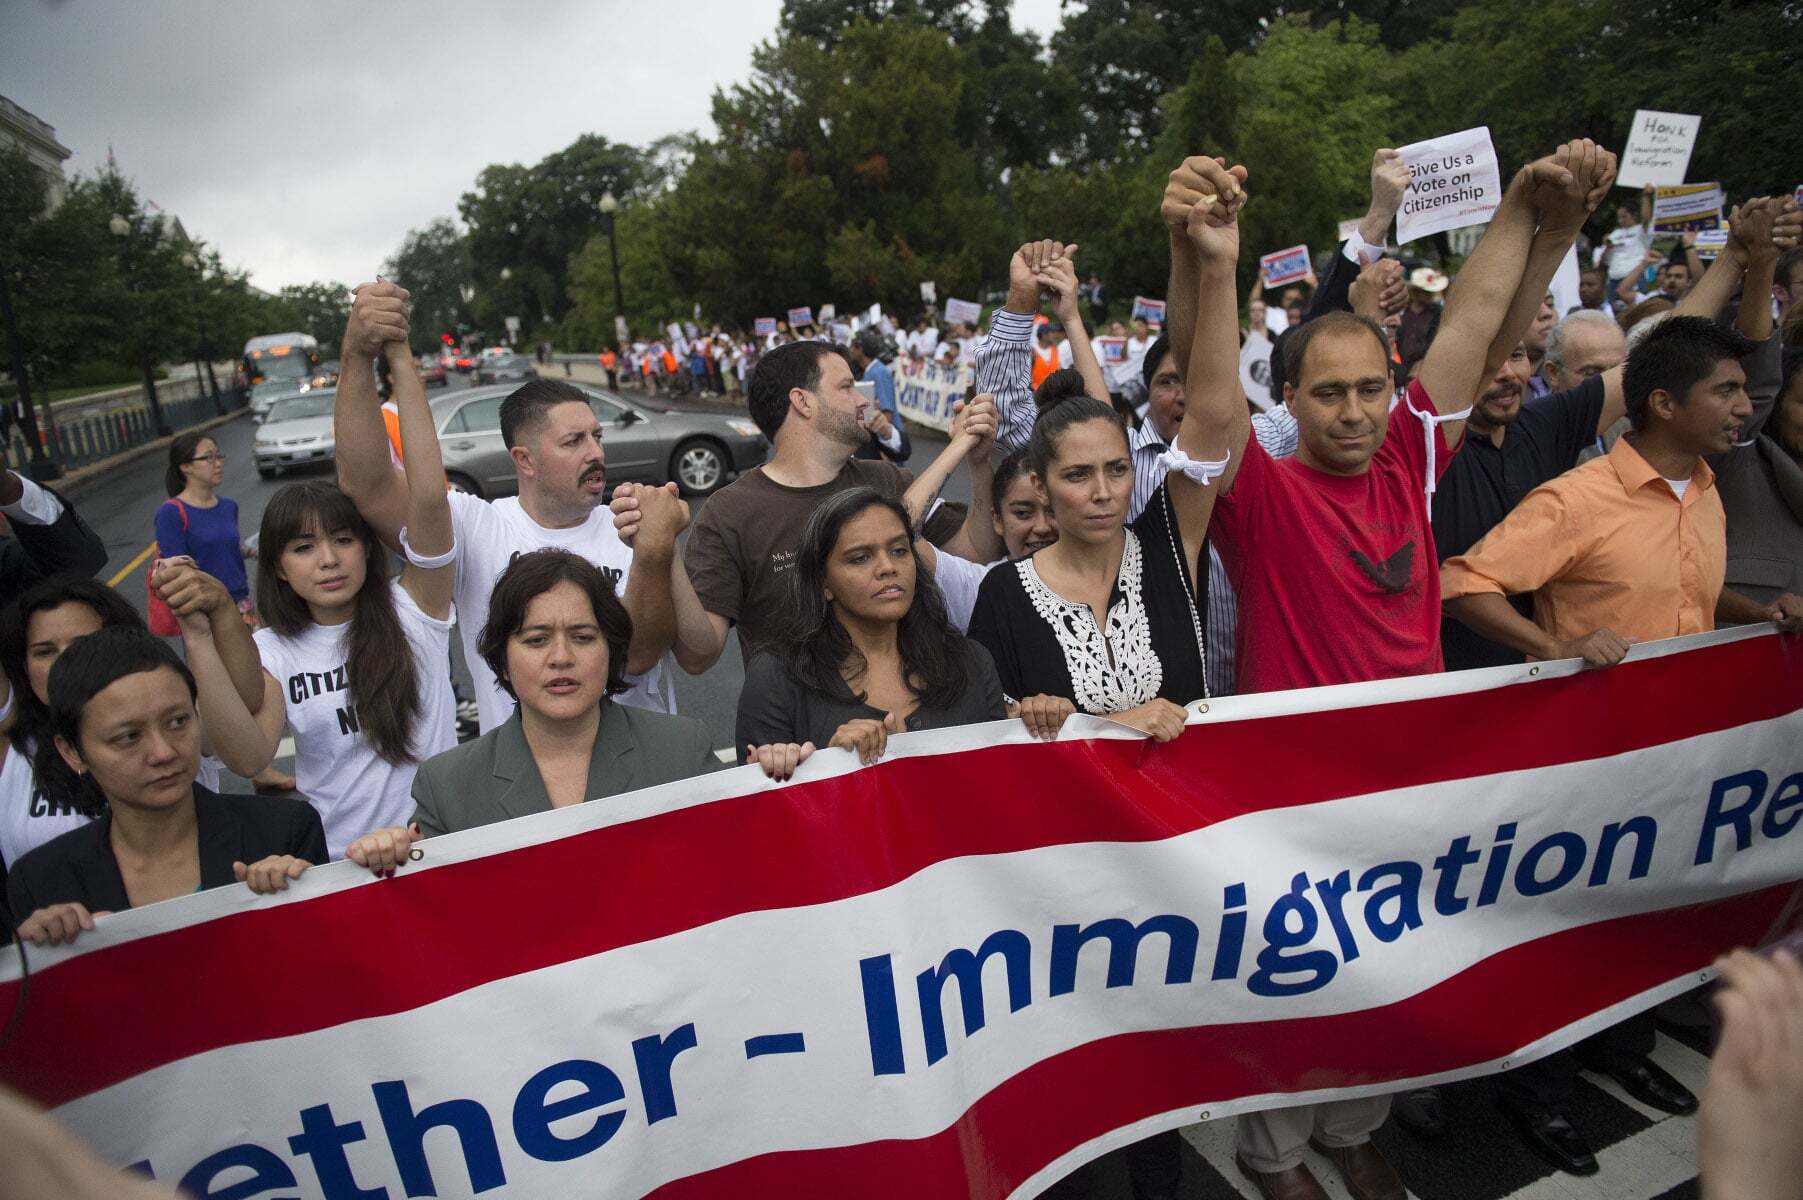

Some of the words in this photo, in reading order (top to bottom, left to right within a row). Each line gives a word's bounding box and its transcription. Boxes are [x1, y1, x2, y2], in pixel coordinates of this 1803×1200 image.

[1408, 162, 1439, 178] Give
[1443, 155, 1462, 170] Us
[1465, 153, 1475, 165] a
[1411, 178, 1447, 195] Vote
[1451, 172, 1471, 186] on
[1403, 185, 1485, 216] Citizenship
[122, 1021, 698, 1200] ether
[858, 821, 1658, 1078] Immigration
